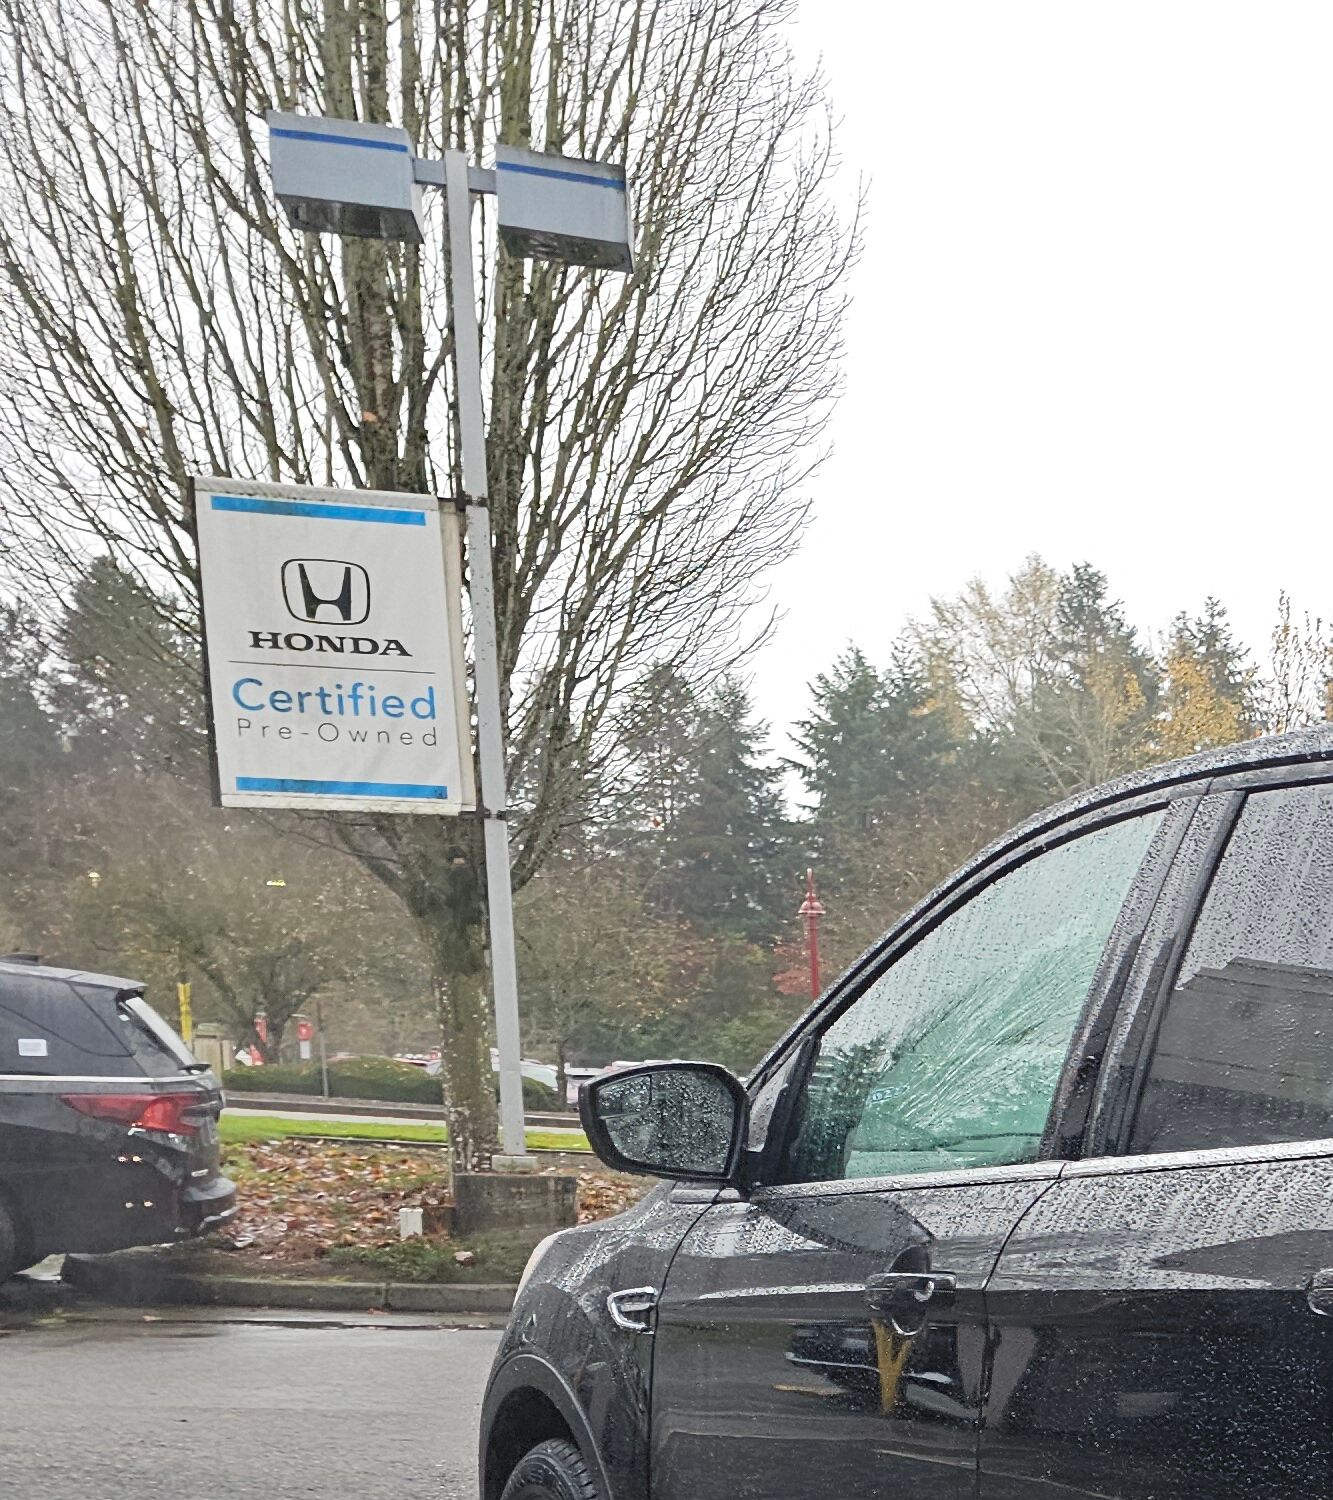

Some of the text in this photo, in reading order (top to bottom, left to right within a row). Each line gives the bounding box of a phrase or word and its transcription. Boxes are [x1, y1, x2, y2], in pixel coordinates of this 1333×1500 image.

[247, 630, 413, 657] HONDA
[232, 677, 437, 720] Certified
[237, 718, 437, 746] Pre-Owned
